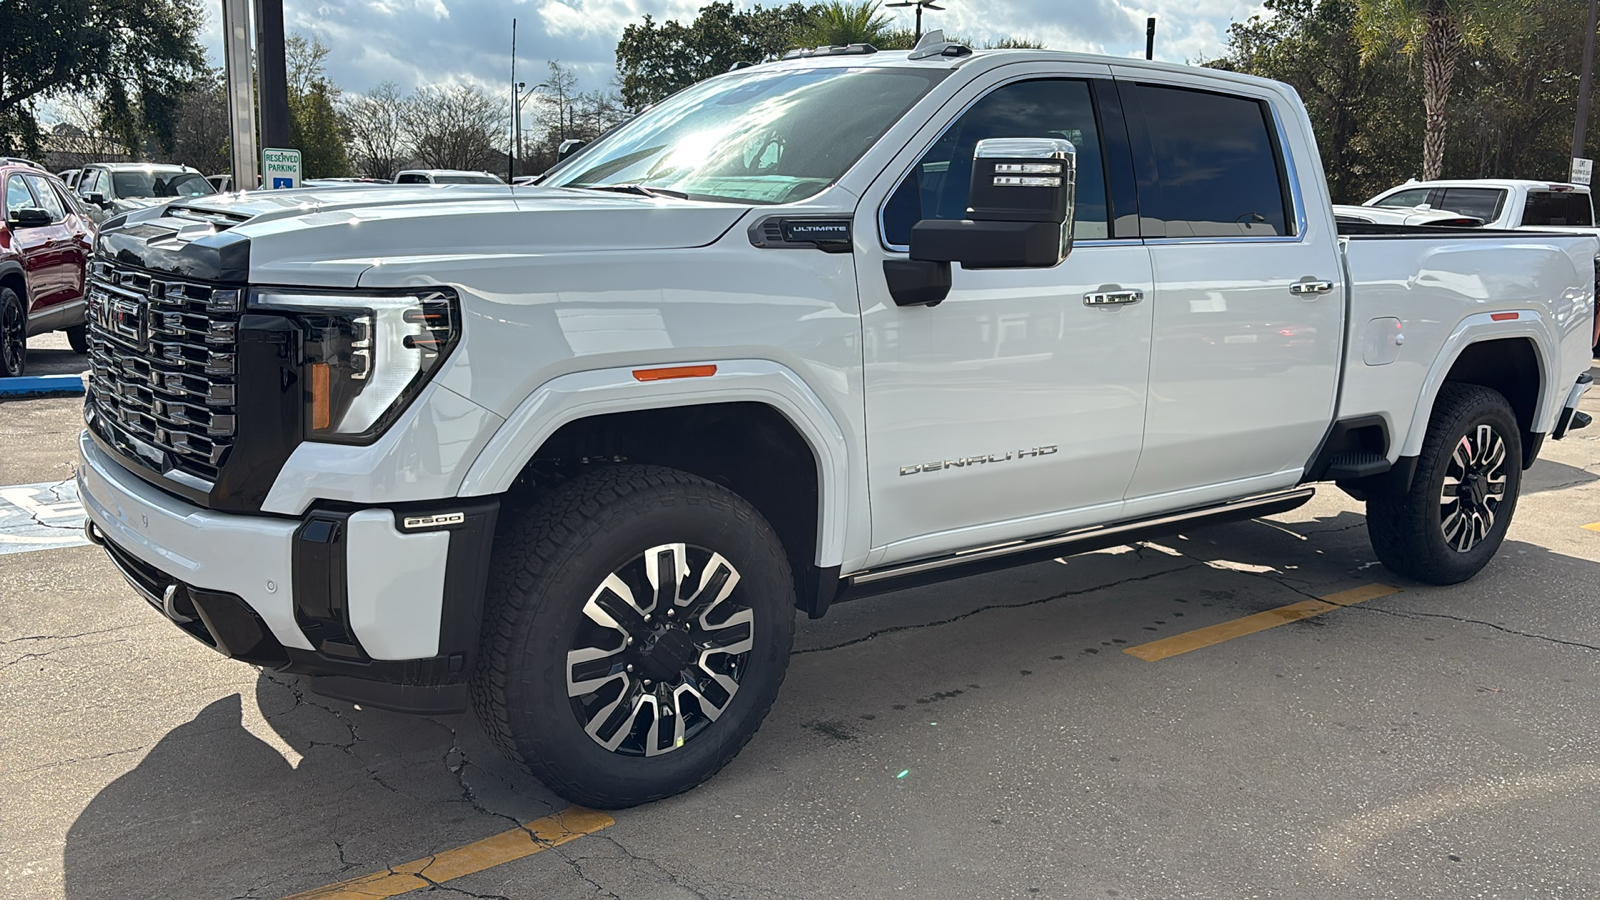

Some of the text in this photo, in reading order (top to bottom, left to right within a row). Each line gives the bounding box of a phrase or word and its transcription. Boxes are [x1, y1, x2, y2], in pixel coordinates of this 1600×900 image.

[265, 154, 299, 163] RESERVED
[268, 163, 297, 172] PARKING
[899, 445, 1058, 476] DENALI HD
[406, 515, 462, 526] 2500
